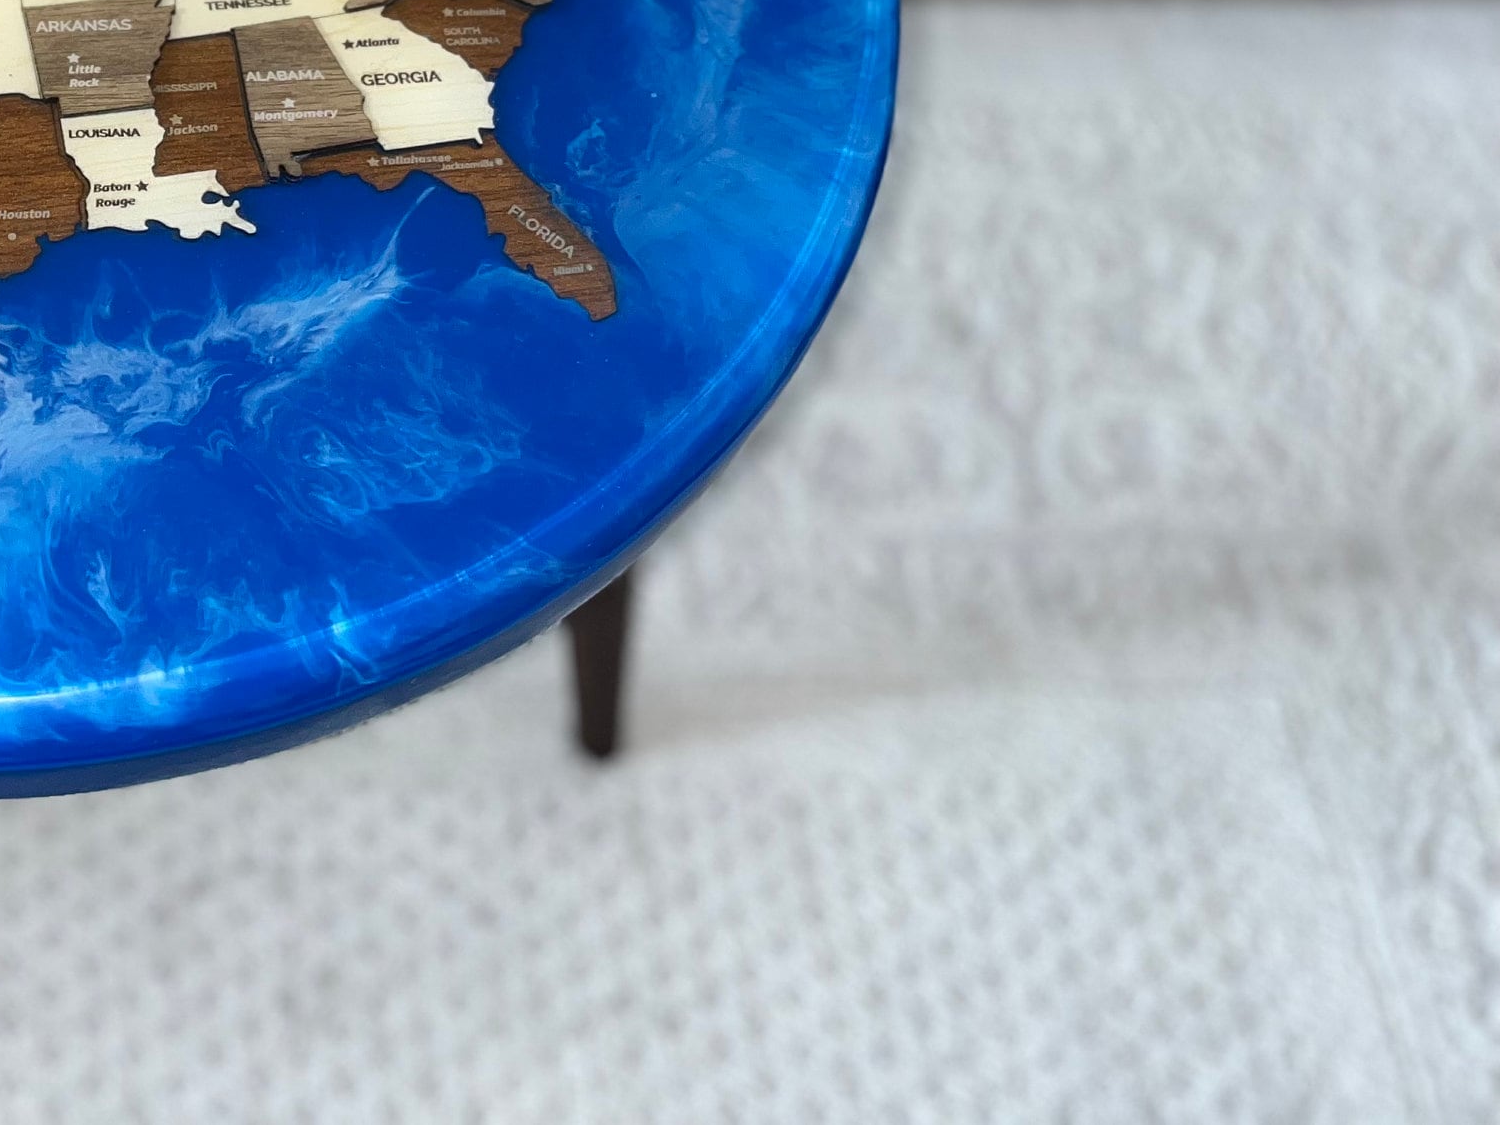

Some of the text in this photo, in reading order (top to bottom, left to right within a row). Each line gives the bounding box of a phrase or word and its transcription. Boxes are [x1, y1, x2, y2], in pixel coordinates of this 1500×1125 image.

[36, 19, 132, 33] ARKANSAS
[443, 26, 481, 37] SOUTH
[356, 37, 400, 48] Atlanta
[446, 35, 500, 47] CAROLINA
[68, 64, 101, 74] Little
[246, 70, 325, 82] ALABAMA
[361, 71, 442, 87] GEORGIA
[69, 78, 100, 88] Rock
[254, 107, 337, 122] Montgomery
[68, 128, 140, 139] LOUISIANA
[167, 123, 218, 136] Jackson
[380, 153, 452, 166] Tallahassee
[93, 182, 131, 193] Baton
[95, 196, 136, 209] Rouge
[507, 204, 575, 260] FLORIDA
[553, 264, 585, 276] Miami
